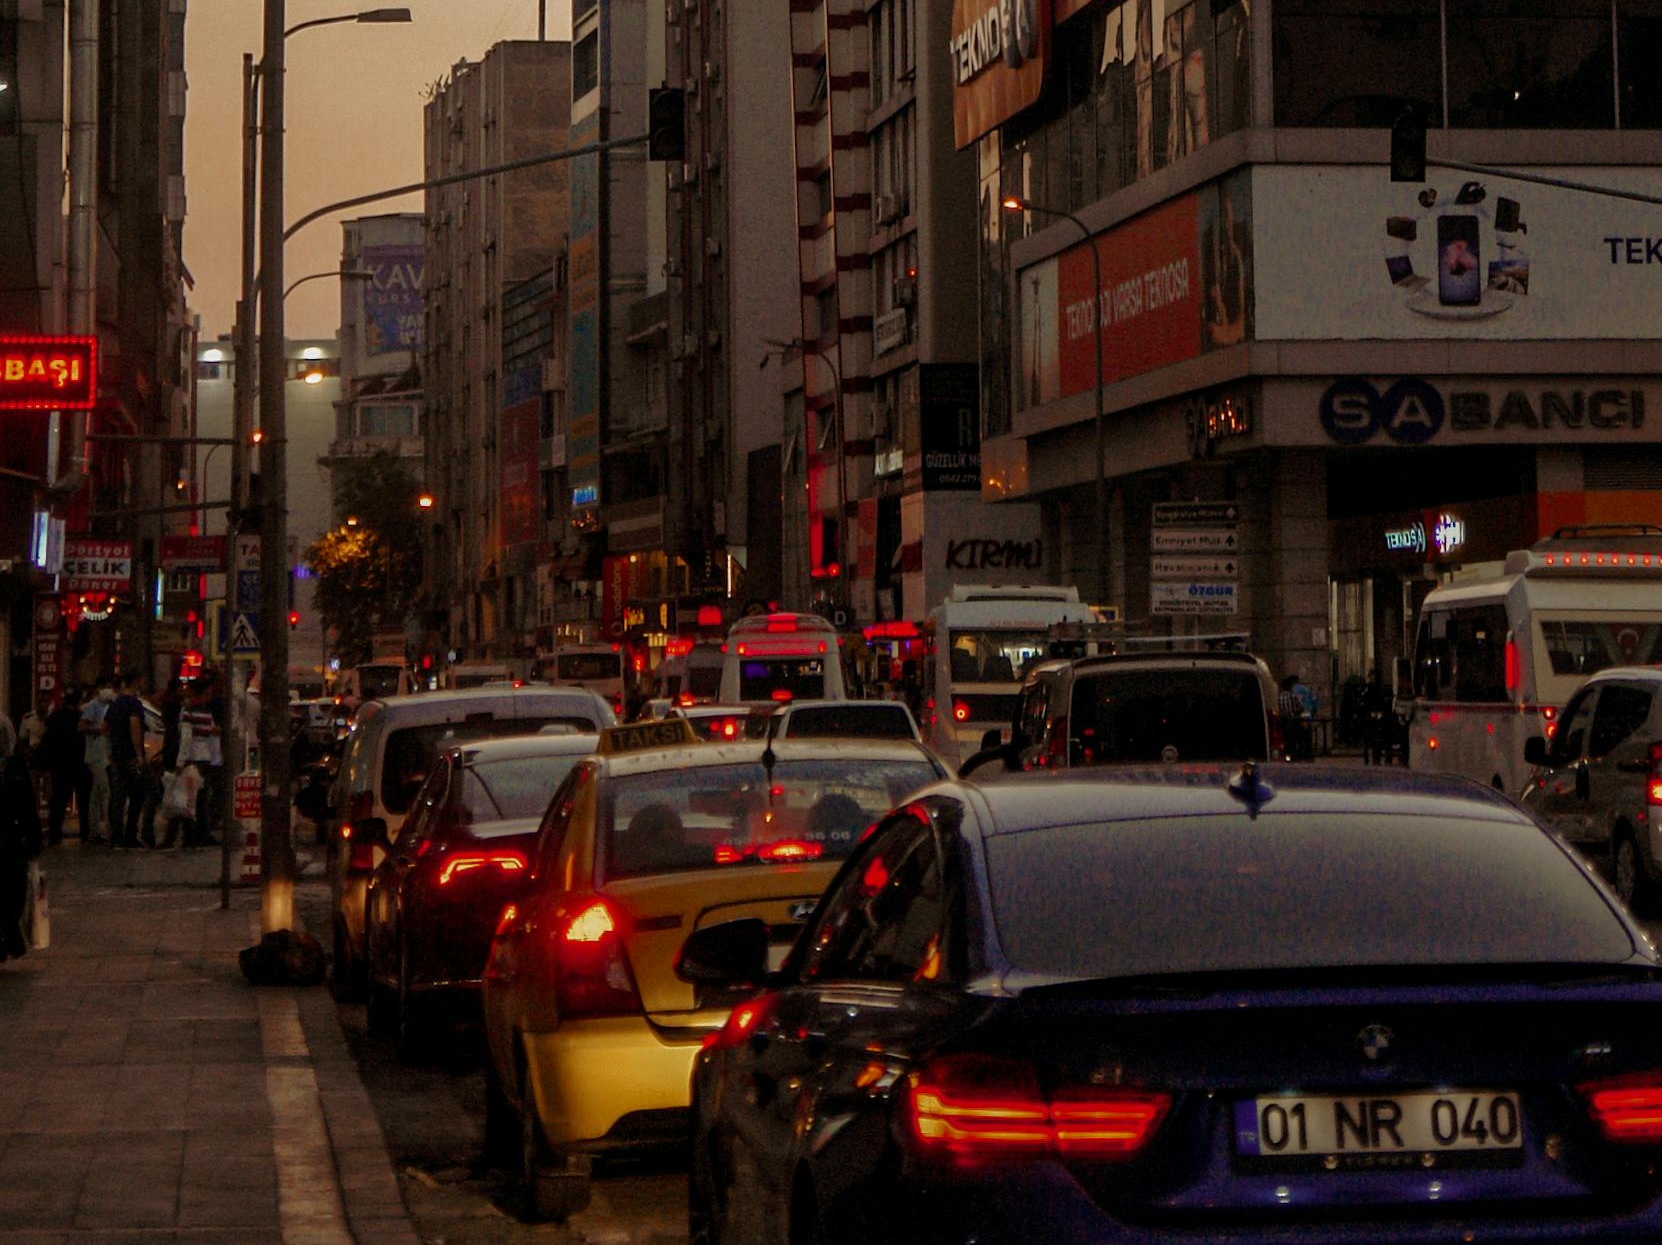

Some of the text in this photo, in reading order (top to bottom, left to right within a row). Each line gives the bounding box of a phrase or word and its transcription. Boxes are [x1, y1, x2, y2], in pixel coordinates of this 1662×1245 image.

[1603, 238, 1662, 264] TEK
[0, 358, 80, 387] BAŞI
[1321, 380, 1644, 442] SABANCI
[64, 561, 125, 578] ÇELİK
[1260, 1095, 1518, 1151] 01 NR 040
